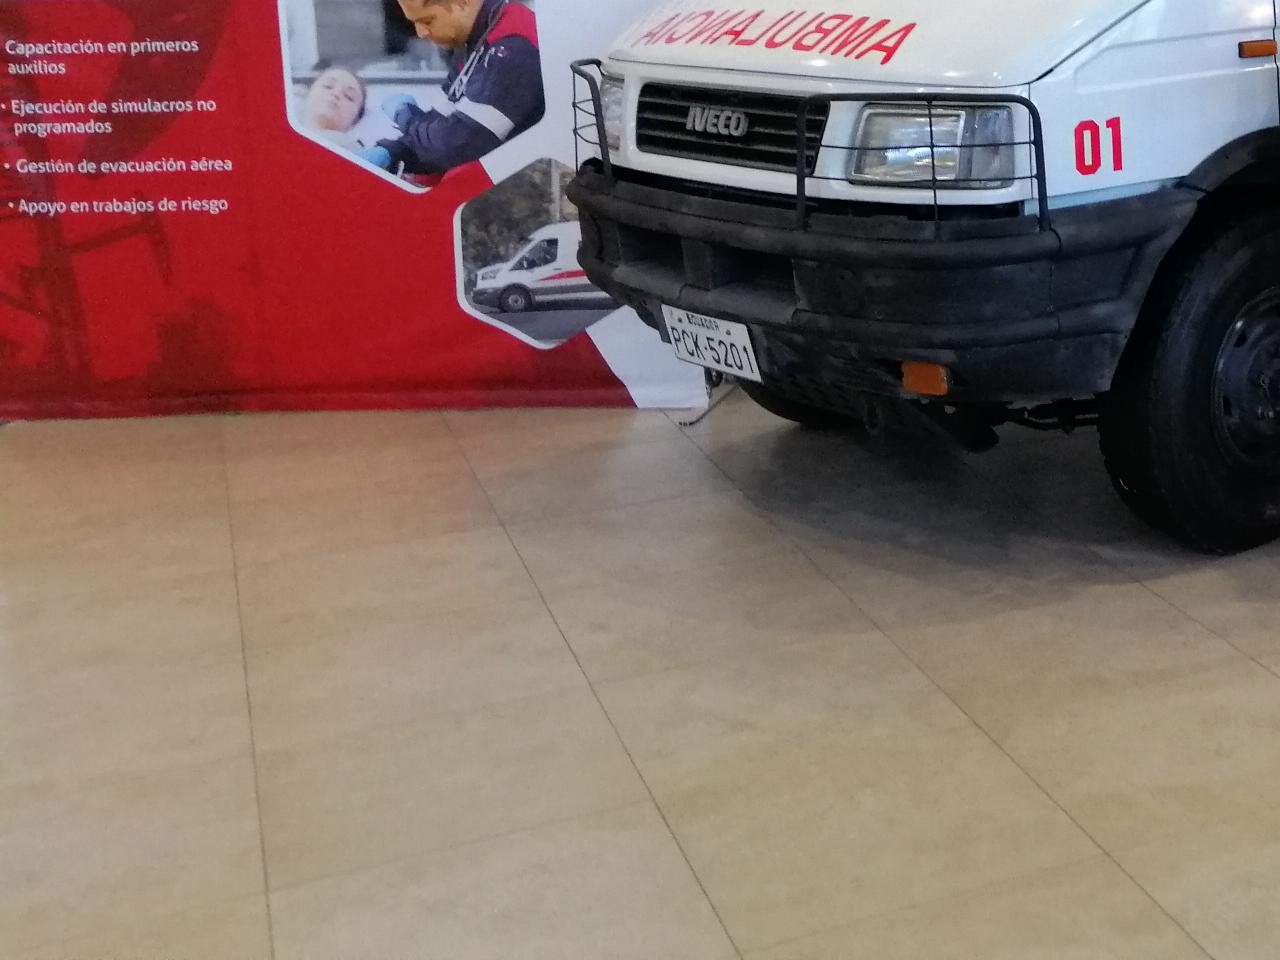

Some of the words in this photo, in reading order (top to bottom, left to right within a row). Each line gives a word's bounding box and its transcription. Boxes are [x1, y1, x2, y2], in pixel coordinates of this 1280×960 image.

[5, 39, 103, 57] Capacitación
[107, 42, 126, 54] en
[130, 38, 199, 56] primeros
[8, 60, 66, 75] auxilios
[11, 99, 84, 117] Ejecución
[88, 99, 108, 113] de
[112, 99, 193, 113] simulacros
[197, 100, 217, 112] no
[14, 119, 112, 138] programados
[686, 103, 748, 136] IVECO
[1074, 117, 1122, 175] 01
[16, 158, 74, 174] Gestión
[78, 159, 97, 173] de
[101, 157, 186, 173] evacuación
[191, 157, 233, 171] aérea
[18, 198, 66, 216] Apoyo
[70, 201, 89, 213] en
[93, 198, 154, 214] trabajos
[158, 198, 177, 211] de
[181, 197, 228, 215] riesgo
